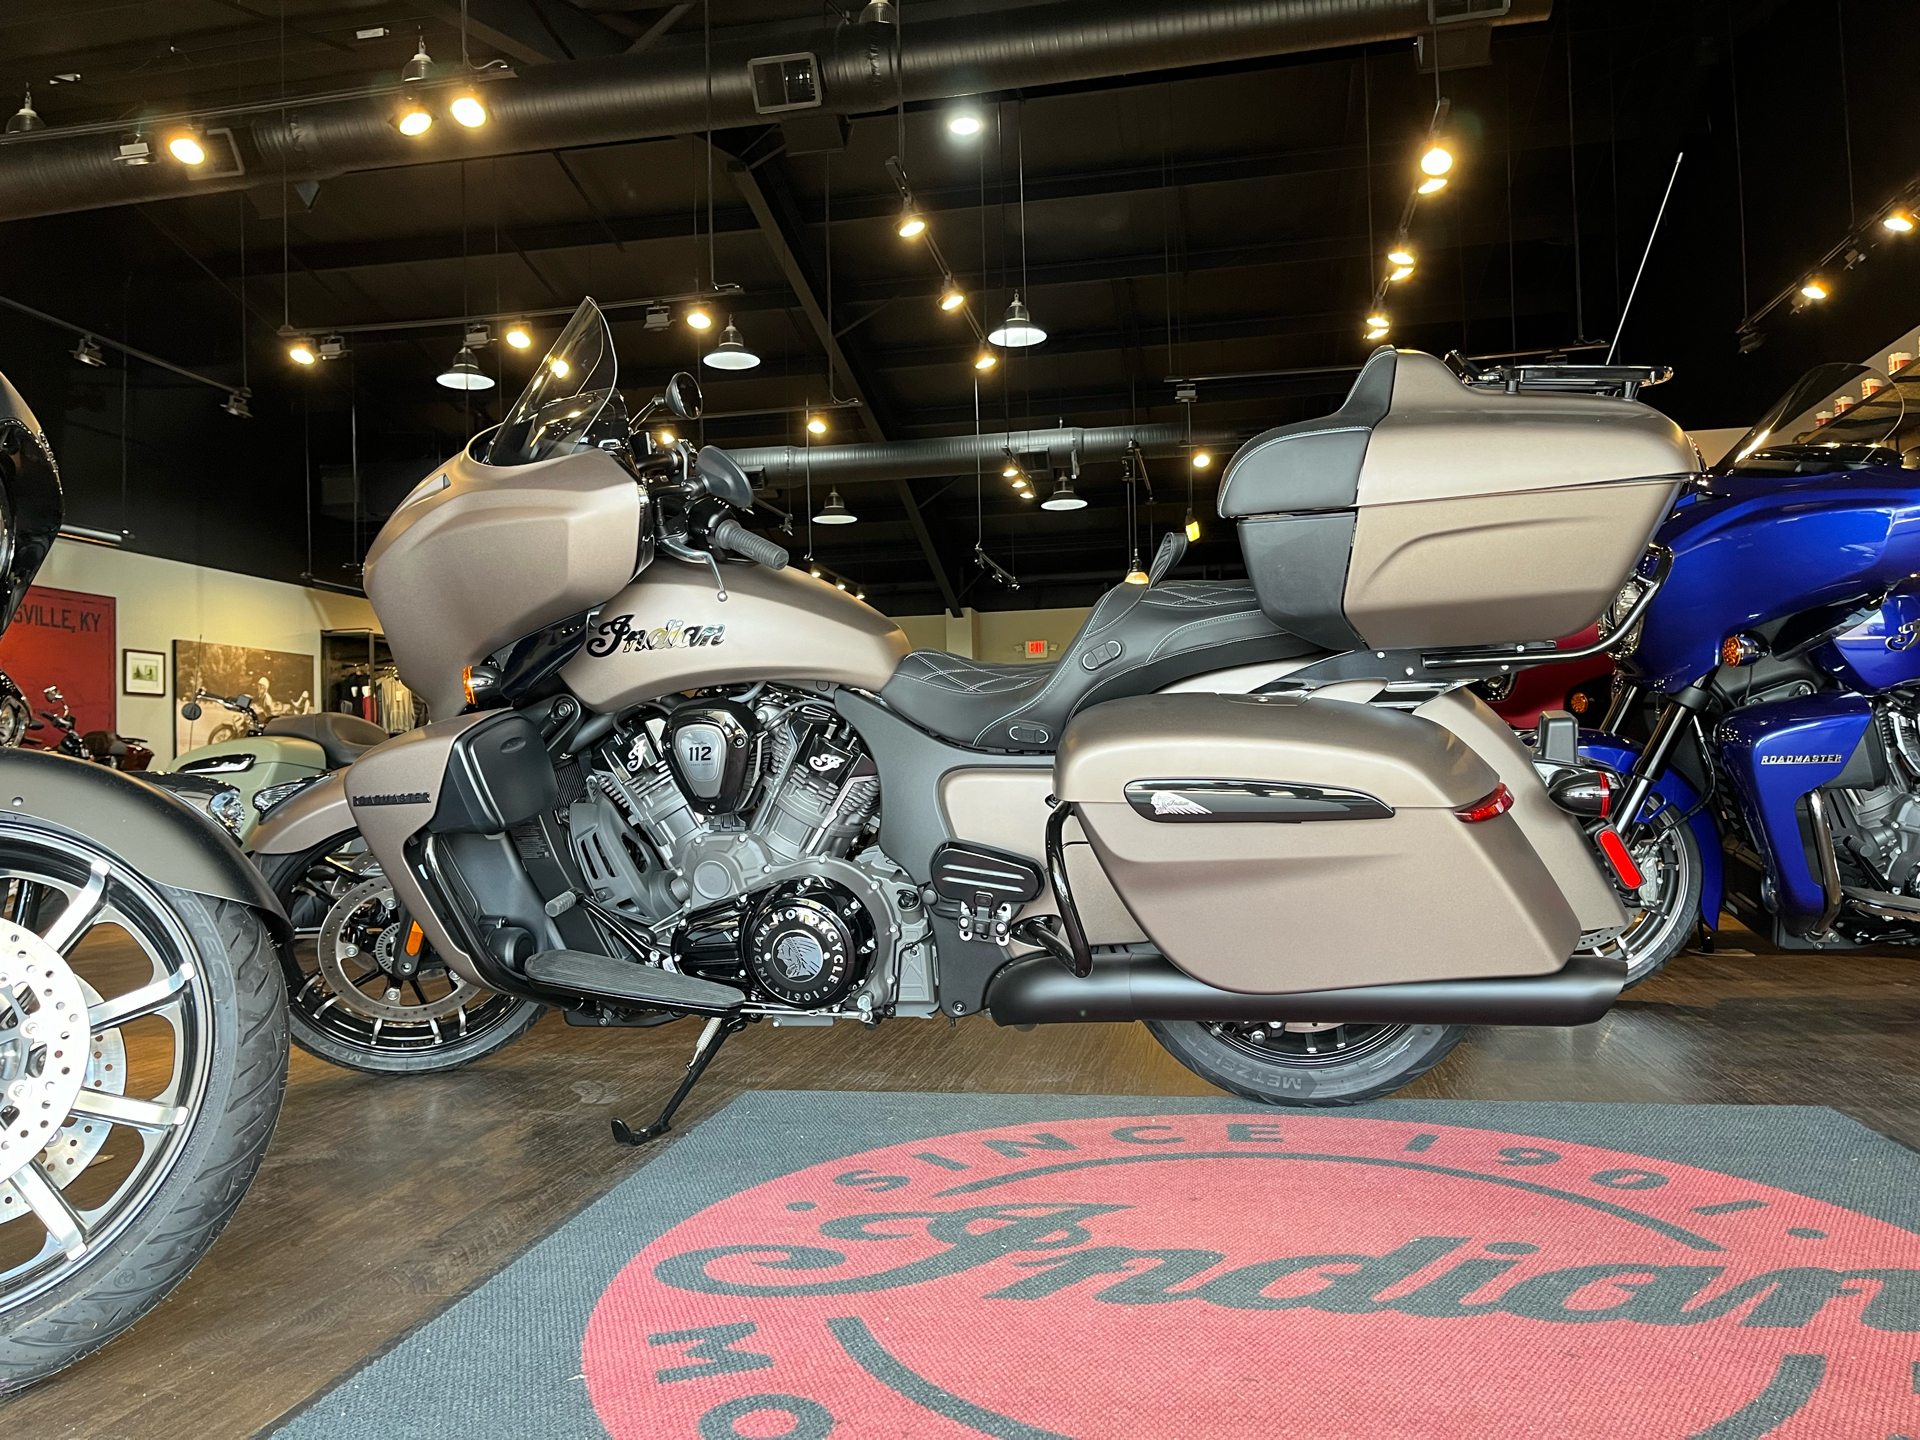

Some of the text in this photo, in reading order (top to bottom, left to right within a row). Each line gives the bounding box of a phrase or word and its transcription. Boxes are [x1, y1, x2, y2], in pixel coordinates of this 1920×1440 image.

[80, 610, 102, 632] KY
[586, 614, 725, 658] Indian
[1028, 640, 1045, 654] EXIT
[689, 746, 712, 761] 112
[1761, 754, 1842, 765] ROADMASTER
[753, 906, 845, 985] INDIAN MOTORCYCLE
[833, 1123, 1769, 1216] SINCE 1901
[654, 1201, 1920, 1332] Indian
